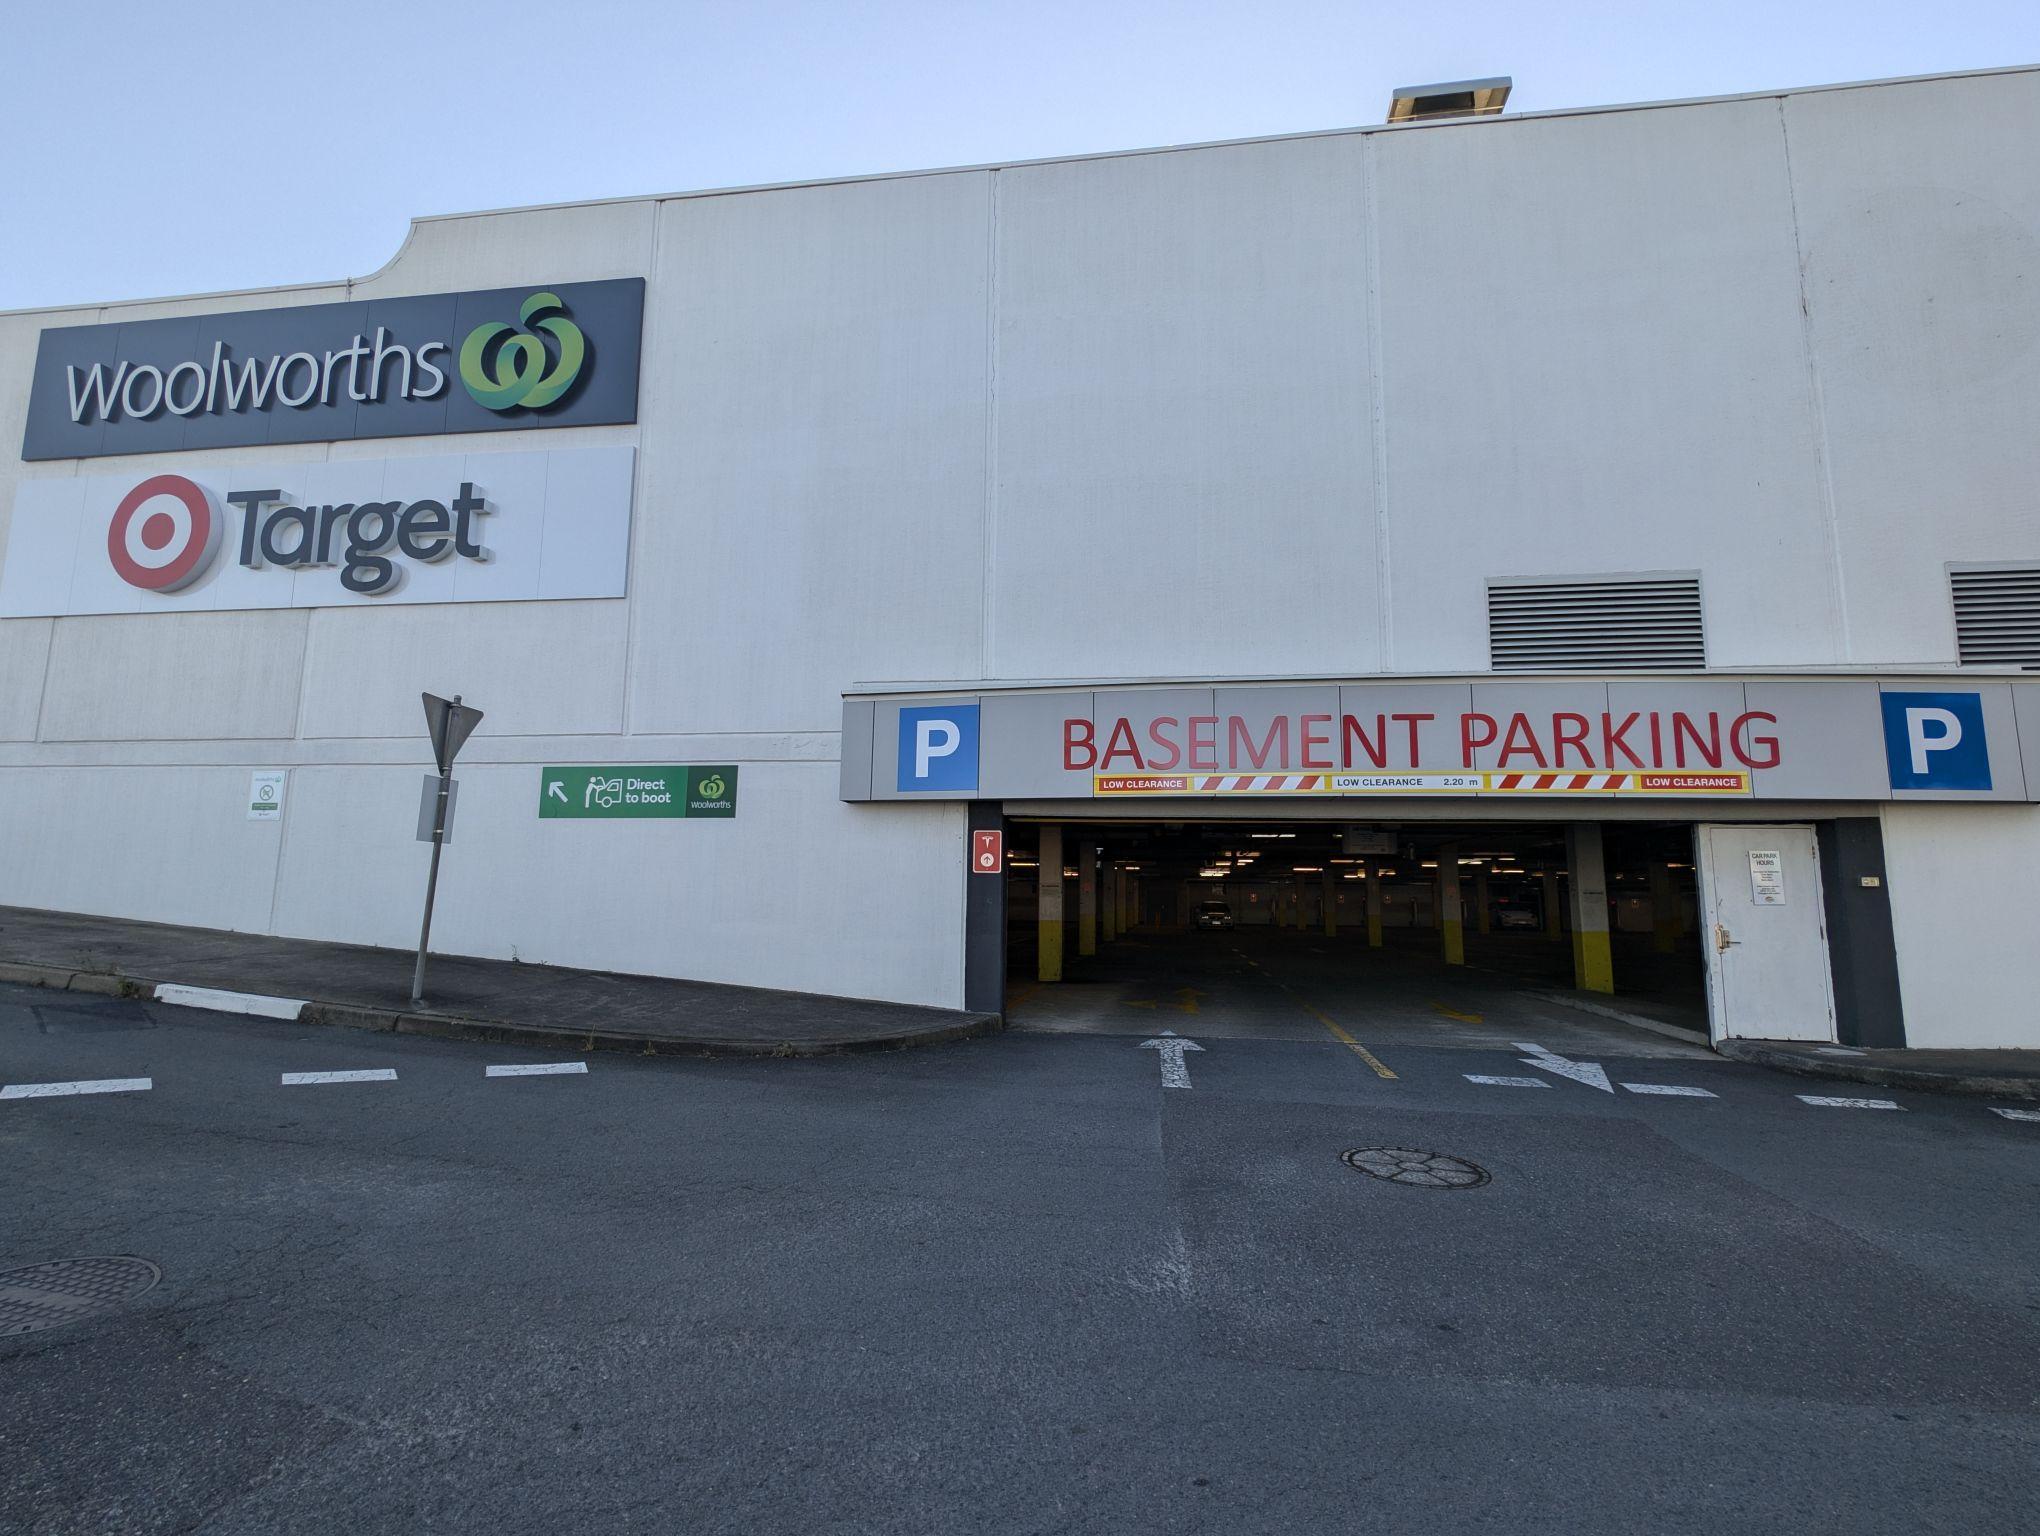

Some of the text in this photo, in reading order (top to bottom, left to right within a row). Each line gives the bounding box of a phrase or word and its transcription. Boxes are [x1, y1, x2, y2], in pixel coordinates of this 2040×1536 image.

[227, 482, 494, 595] Target
[1063, 711, 1782, 771] BASEMENT PARKING
[1905, 707, 1963, 774] P
[915, 719, 961, 778] P
[627, 778, 666, 790] Direct
[1103, 780, 1182, 789] LOW CLEARANCE
[1337, 778, 1359, 787] LOW
[1362, 778, 1424, 787] CLEARANCE
[1443, 778, 1464, 786] 2.20
[1646, 778, 1737, 786] LOW CLEARANCE
[625, 791, 672, 804] to boot
